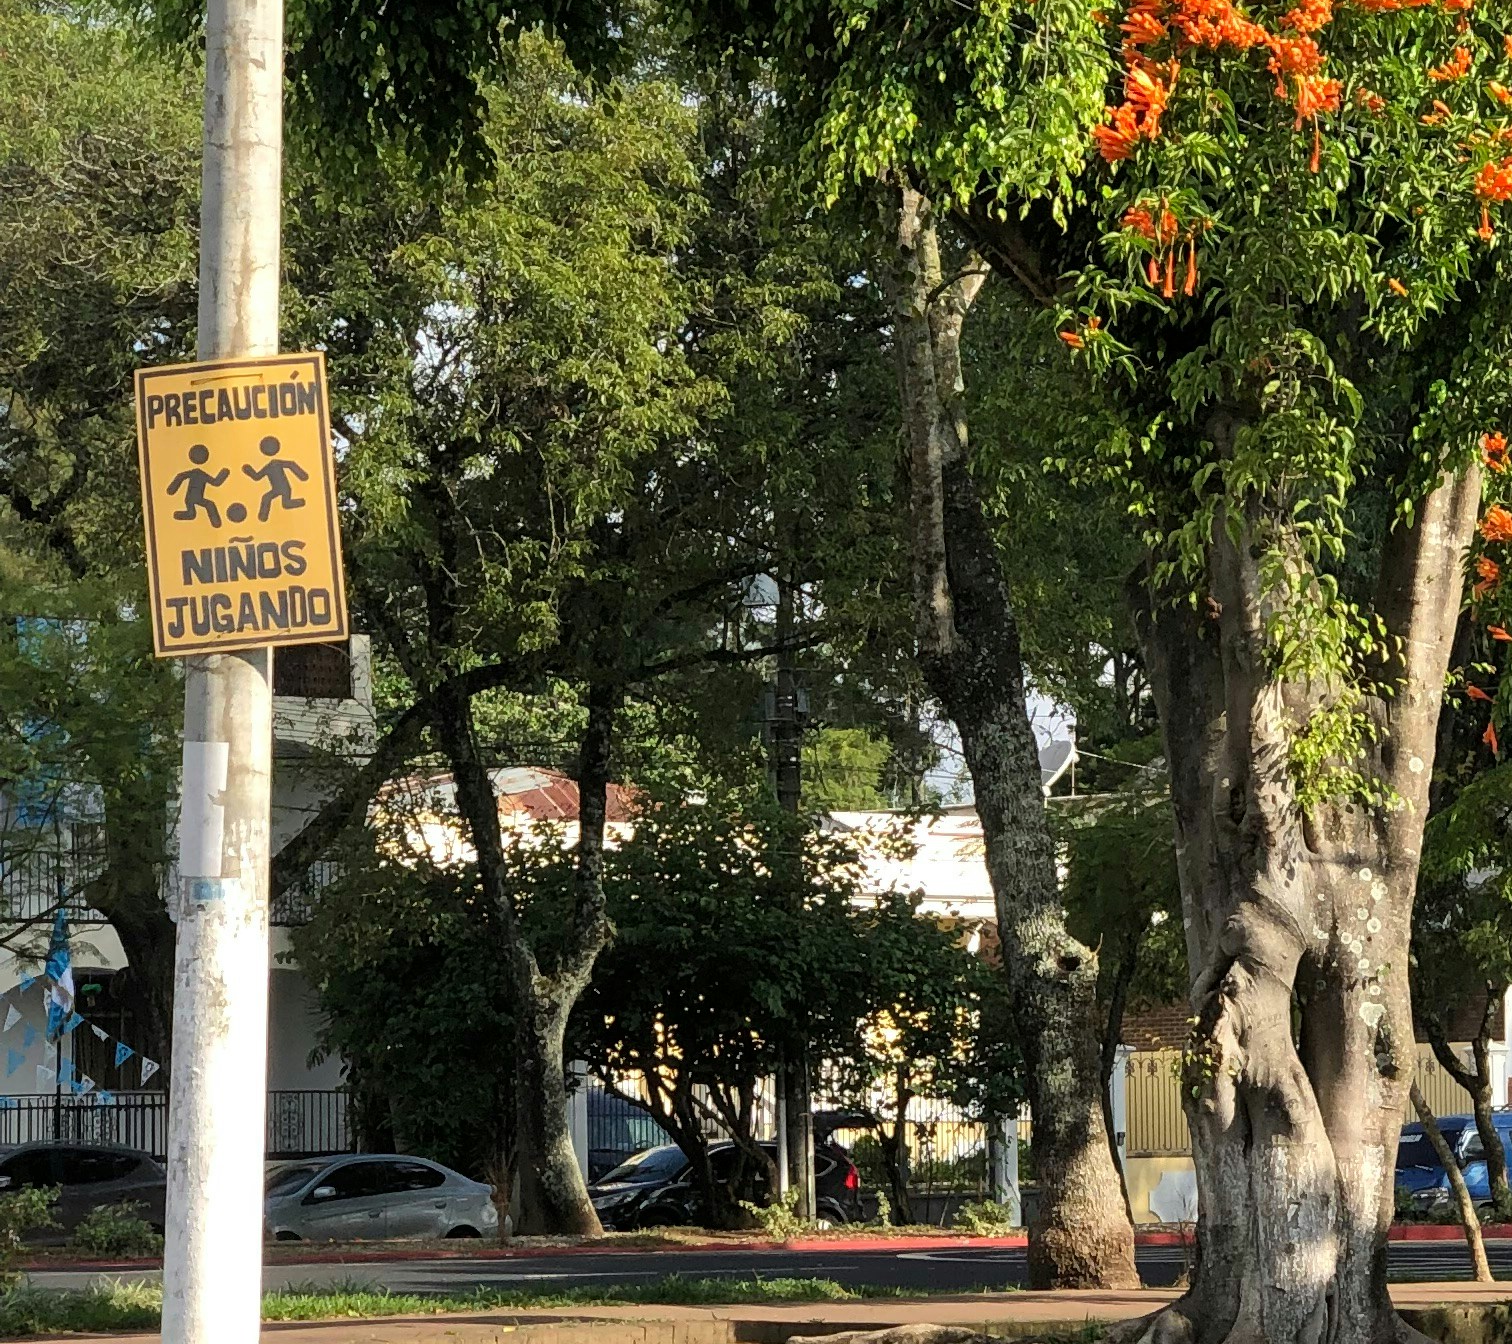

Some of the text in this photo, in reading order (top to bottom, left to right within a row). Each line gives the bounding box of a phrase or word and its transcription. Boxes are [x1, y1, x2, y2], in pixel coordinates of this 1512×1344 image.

[147, 370, 317, 429] PRECAUCIÓN
[181, 535, 307, 586] NIÑOS
[165, 585, 331, 639] JUGANDO
